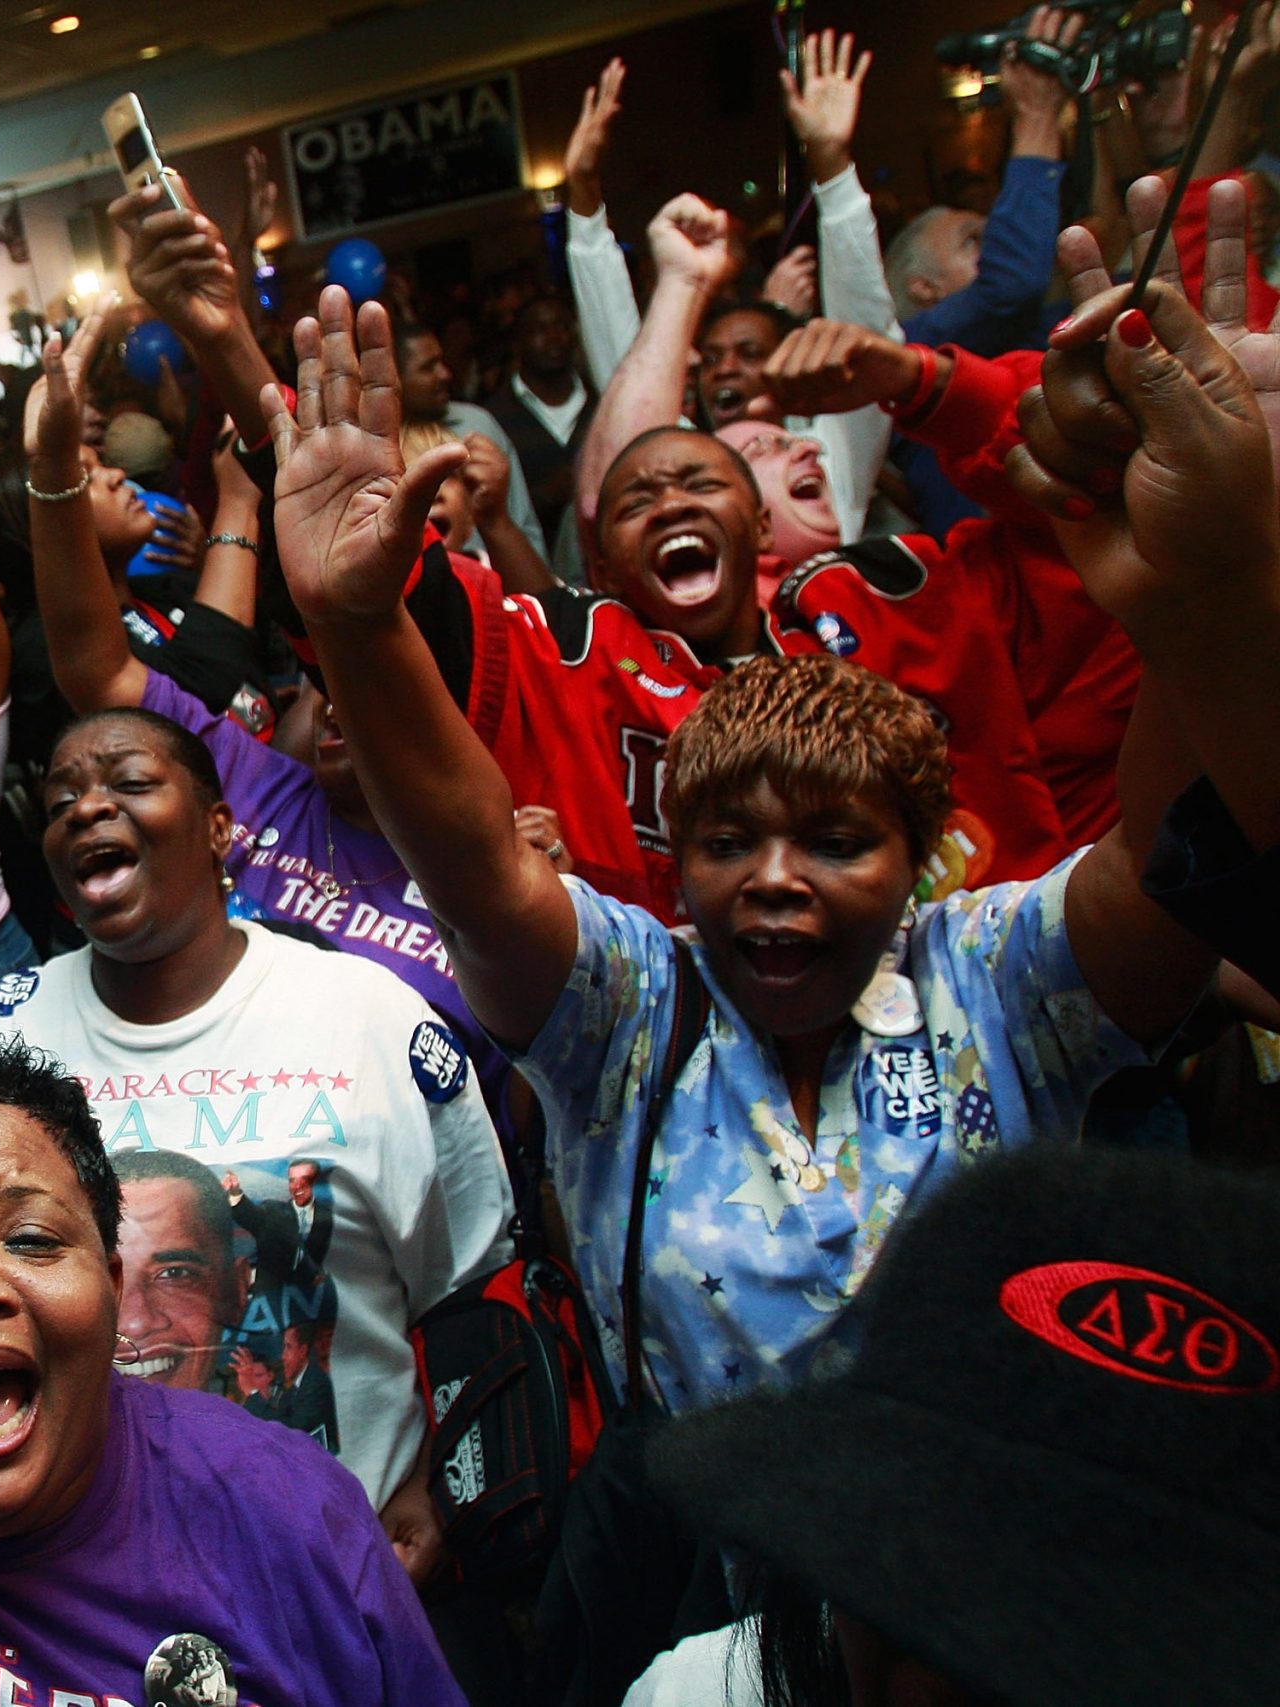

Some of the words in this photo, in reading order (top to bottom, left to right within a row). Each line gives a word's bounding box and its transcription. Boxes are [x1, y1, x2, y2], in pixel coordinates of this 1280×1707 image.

[296, 83, 510, 172] OBAMA
[275, 877, 350, 931] THE
[344, 901, 456, 977] DREA
[410, 1022, 435, 1061] YES
[422, 1032, 450, 1076] WE
[437, 1047, 461, 1089] CAN
[872, 1051, 930, 1075] YES
[80, 1068, 237, 1102] BARACK
[876, 1071, 939, 1099] WE
[885, 1091, 950, 1119] CAN
[103, 1090, 348, 1153] AMA
[1076, 1287, 1239, 1378] ΔΣΘ
